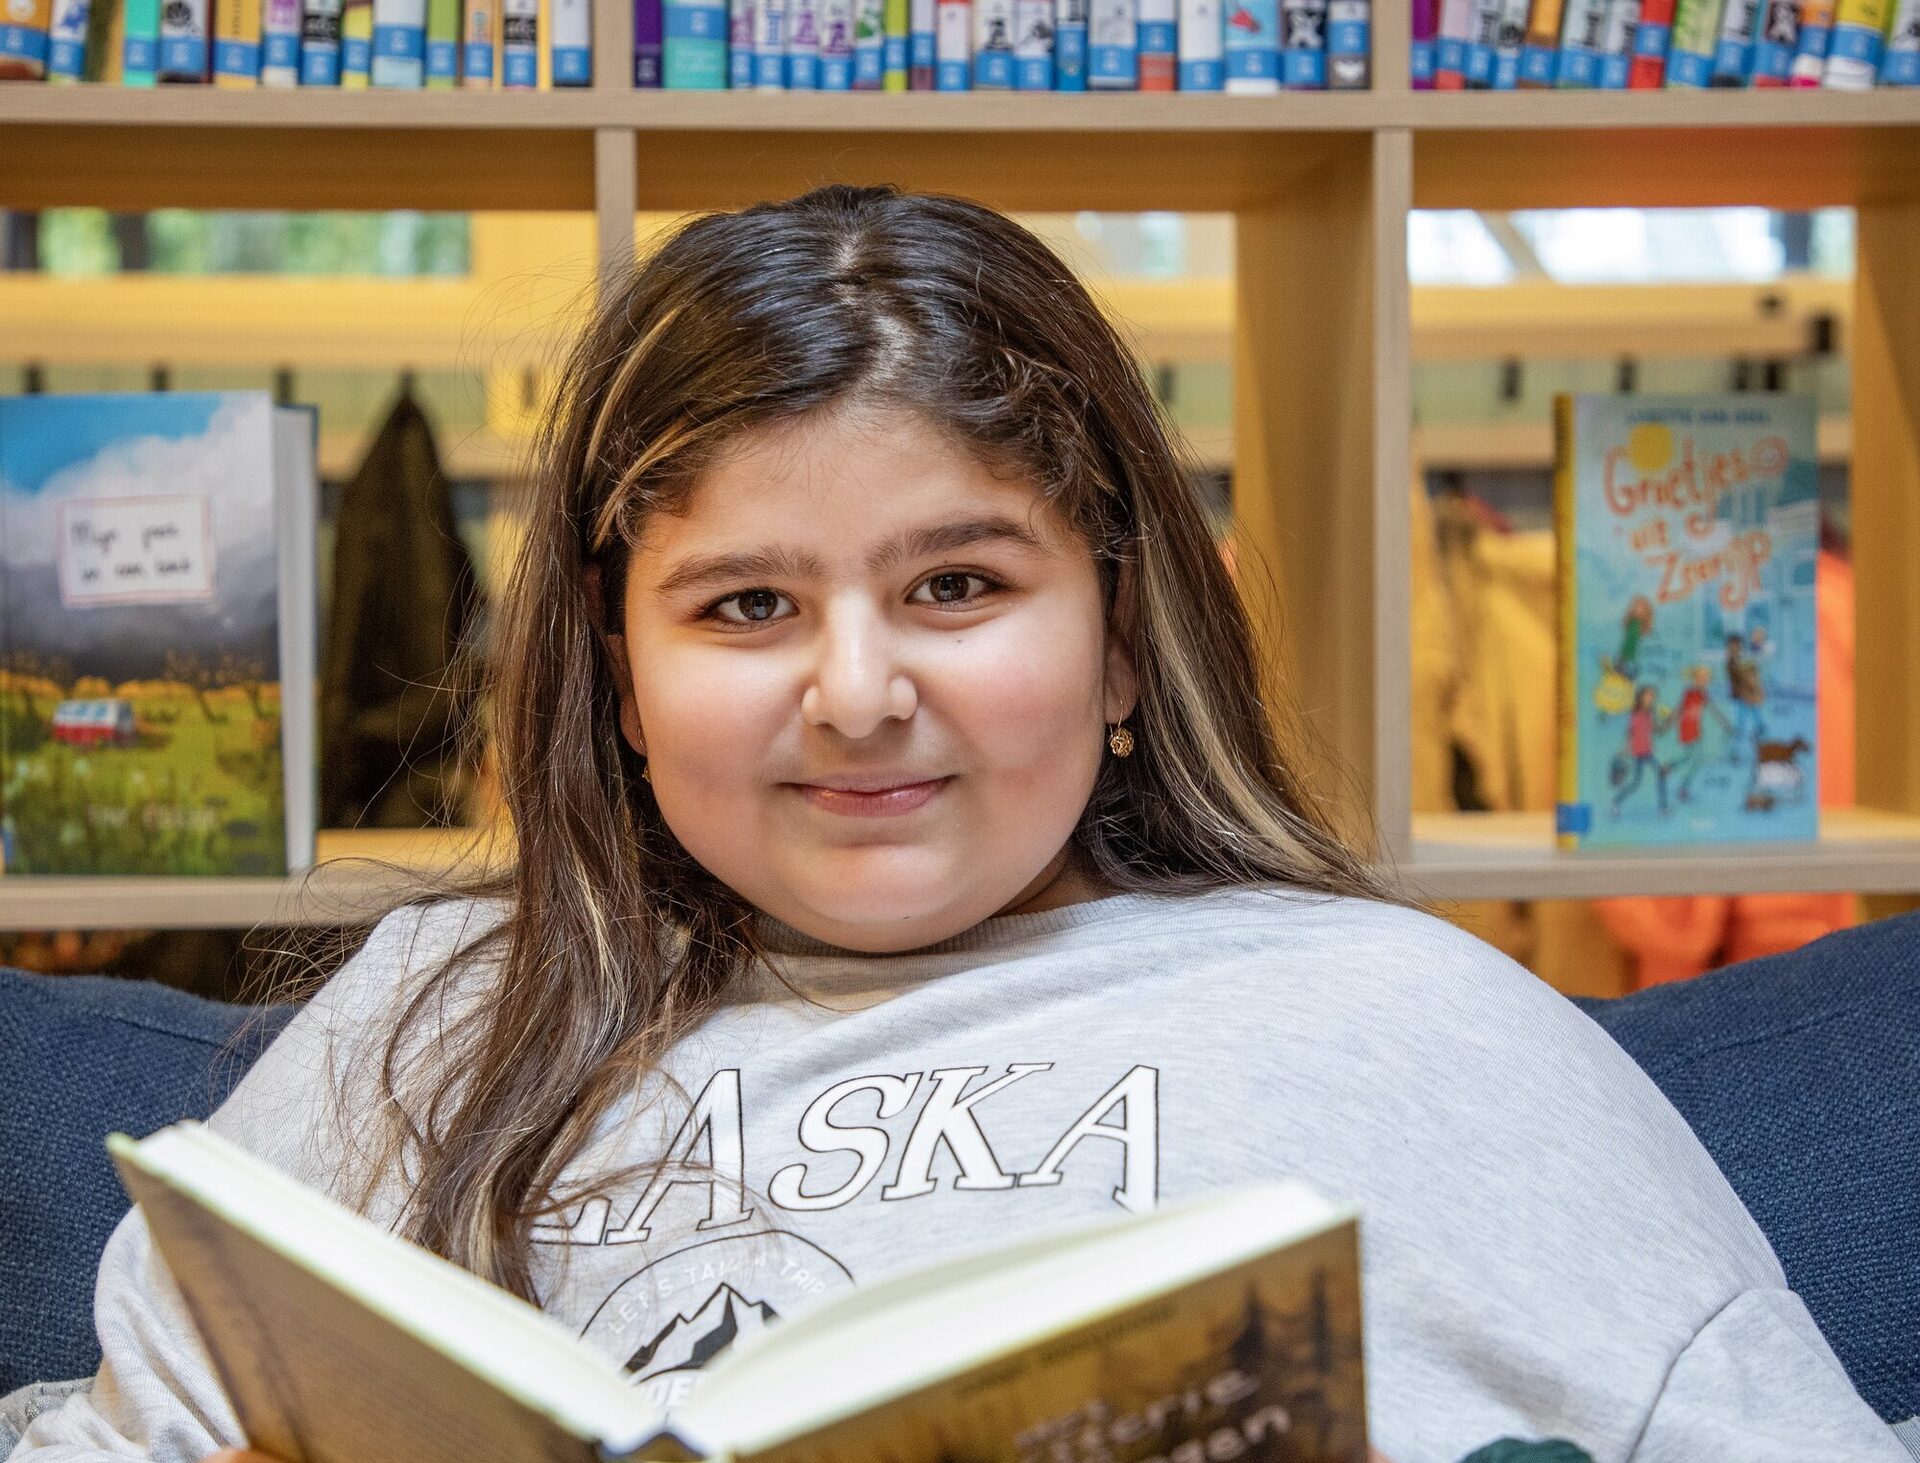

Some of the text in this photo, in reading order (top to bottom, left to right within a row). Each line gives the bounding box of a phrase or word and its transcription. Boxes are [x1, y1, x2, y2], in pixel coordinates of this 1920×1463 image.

[529, 1062, 1159, 1246] ASKA
[608, 1278, 673, 1334] LETS
[780, 1259, 825, 1294] TRIP
